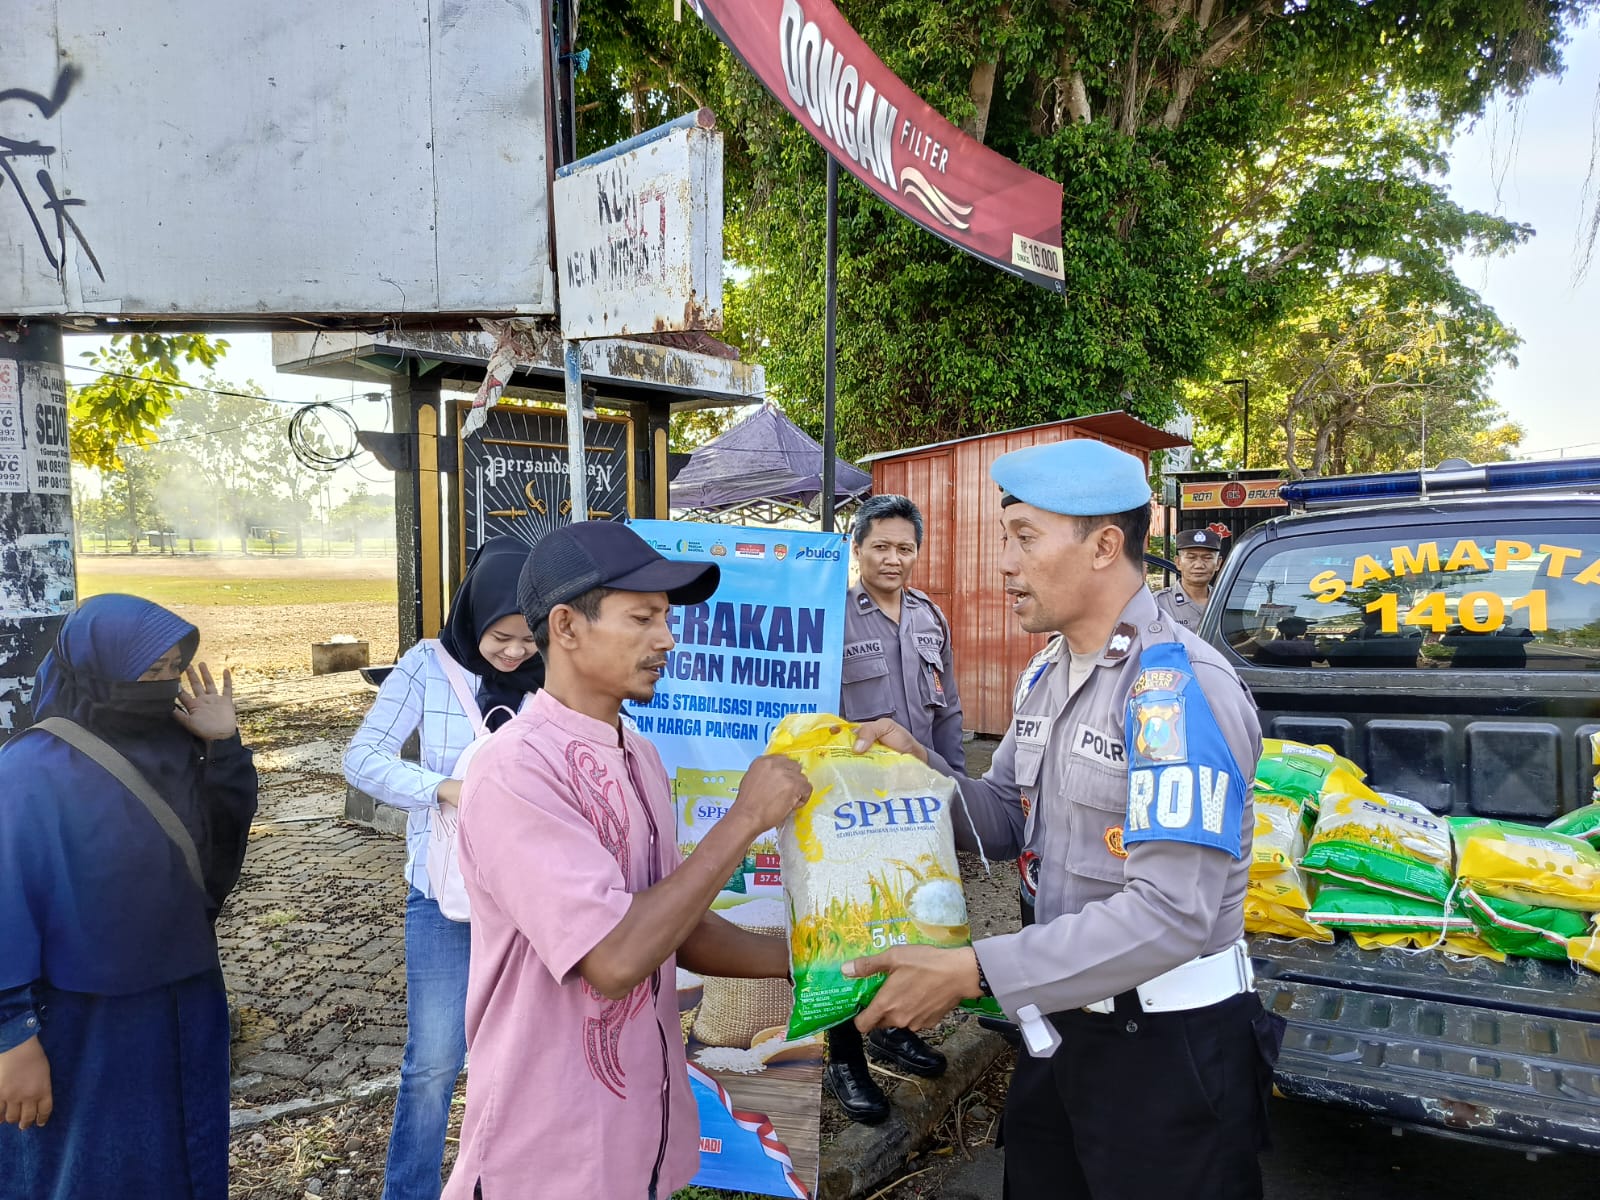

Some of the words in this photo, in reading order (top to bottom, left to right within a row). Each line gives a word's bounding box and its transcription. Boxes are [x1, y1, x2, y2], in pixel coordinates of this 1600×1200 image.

[780, 0, 898, 191] DONGAN
[901, 120, 949, 174] FILTER
[1029, 244, 1059, 273] 16.000
[482, 454, 612, 492] PersaudaaN
[806, 547, 841, 562] bulog
[1366, 589, 1548, 633] 1401
[732, 656, 820, 690] MURAH
[673, 693, 752, 717] STABILISASI
[657, 717, 702, 736] HARGA
[705, 720, 758, 741] PANGAN
[833, 796, 941, 832] SPHP
[872, 927, 886, 949] 5
